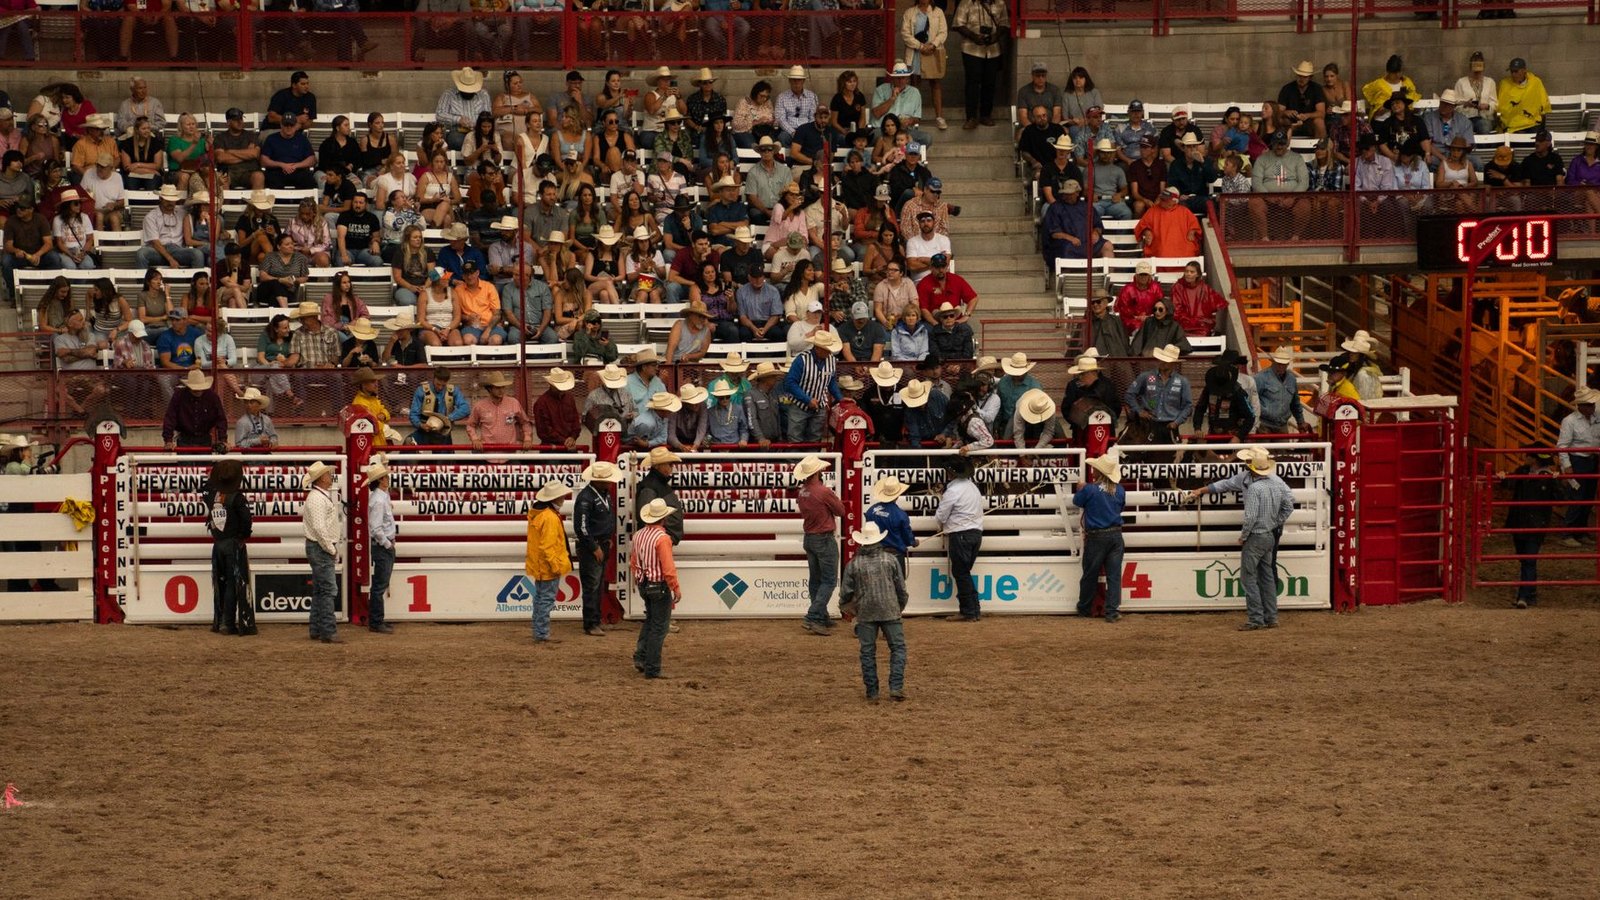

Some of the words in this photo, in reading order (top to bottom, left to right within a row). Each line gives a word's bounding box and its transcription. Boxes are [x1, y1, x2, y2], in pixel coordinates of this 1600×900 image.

[877, 469, 944, 484] CHEYENN
[1120, 464, 1196, 479] CHEYENNE
[1201, 464, 1249, 479] FRONT
[390, 474, 459, 488] HEYENNE
[463, 474, 534, 489] FRONTIER
[714, 472, 784, 487] FRONTIER
[1209, 490, 1227, 505] OF
[160, 502, 205, 517] "DADD
[469, 500, 487, 515] OF
[719, 499, 736, 513] OF
[117, 463, 126, 605] CHEYENNE
[618, 460, 627, 600] CHEYENNE
[754, 578, 800, 590] Cheyenne
[930, 568, 1019, 601] bue
[1121, 562, 1152, 598] 4
[1193, 569, 1309, 598] Unn
[165, 575, 199, 613] 0
[407, 575, 431, 612] 1
[763, 590, 799, 600] Medical
[495, 604, 532, 613] Albertso
